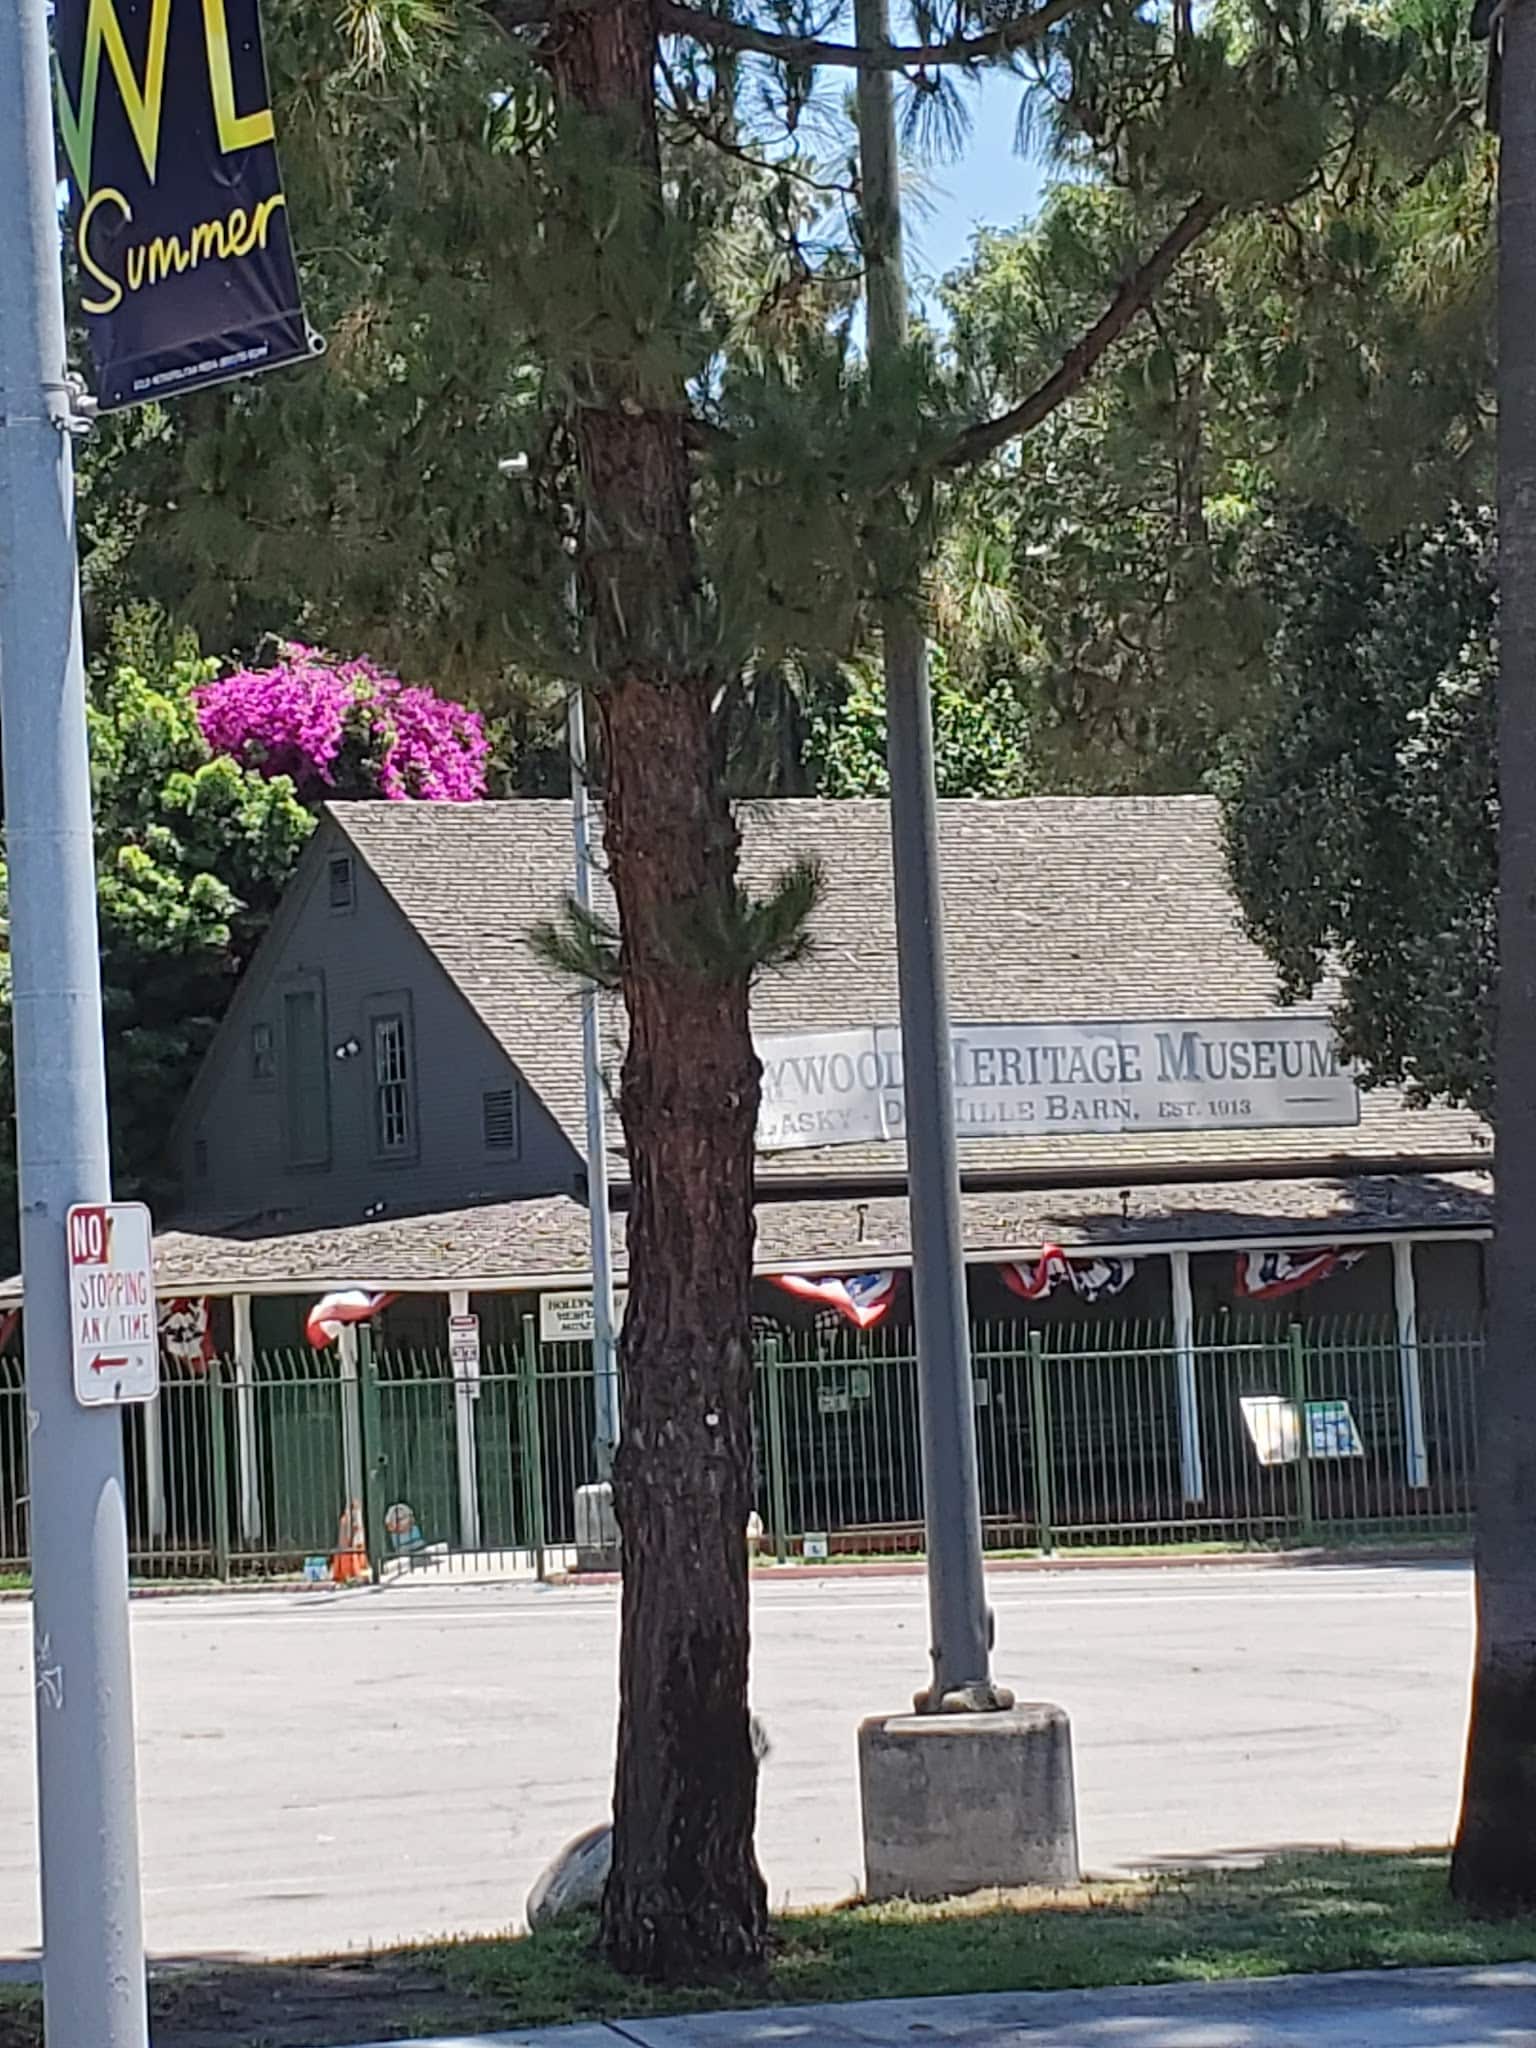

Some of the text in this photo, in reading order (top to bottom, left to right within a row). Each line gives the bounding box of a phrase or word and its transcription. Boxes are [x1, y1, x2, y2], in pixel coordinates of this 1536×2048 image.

[78, 187, 286, 314] Summer
[1154, 1031, 1341, 1082] MUSEUM
[1045, 1095, 1140, 1121] BARN.
[72, 1214, 103, 1258] NO
[80, 1271, 147, 1310] STOPPING
[82, 1313, 150, 1344] ANY TIME
